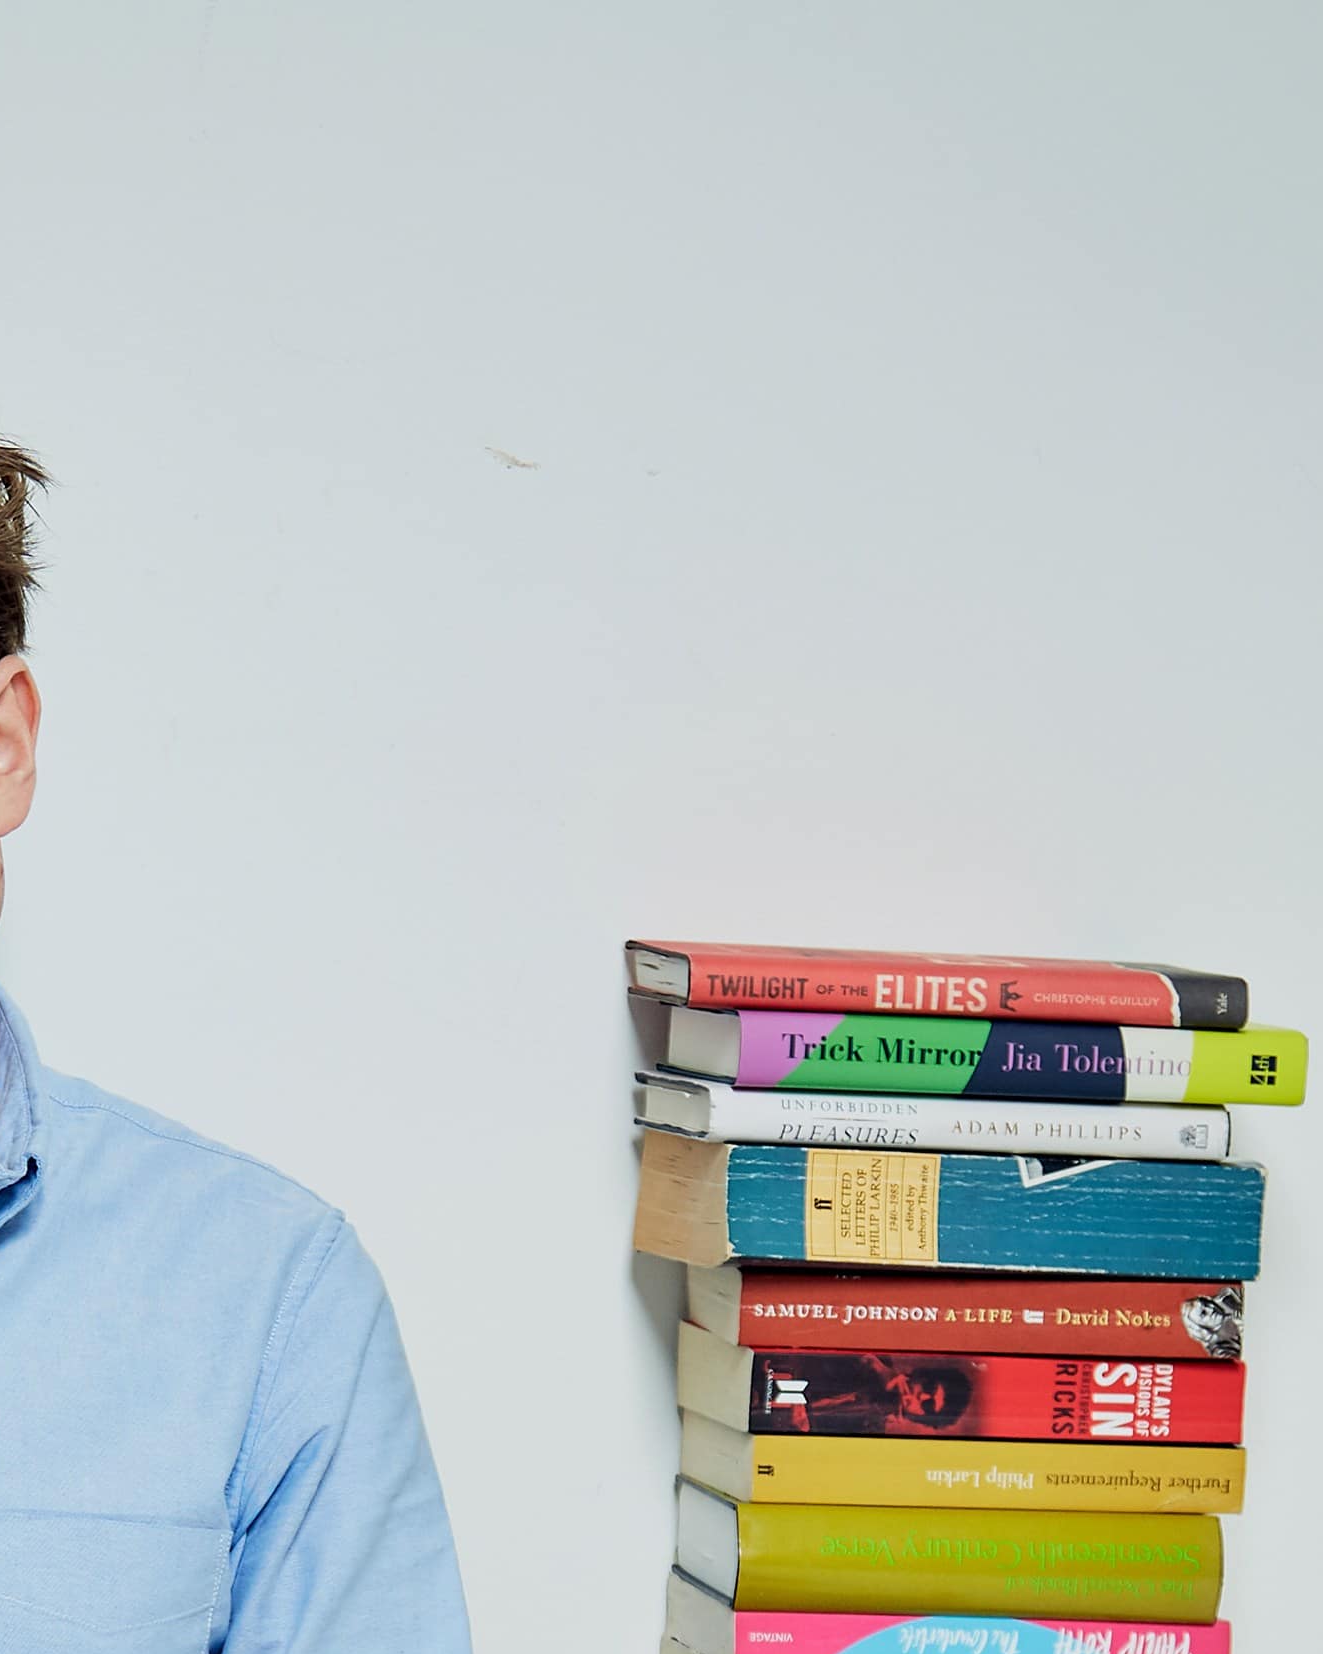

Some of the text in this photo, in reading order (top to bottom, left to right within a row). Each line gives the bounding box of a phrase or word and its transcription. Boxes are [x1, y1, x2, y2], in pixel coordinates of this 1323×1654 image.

[707, 974, 988, 1013] TWILIGHT OF THE ELITES
[782, 1033, 983, 1067] Trick Mirror
[1002, 1042, 1192, 1077] Jia Tolentino
[780, 1099, 919, 1115] UNFORBIDDEN
[779, 1124, 920, 1145] PLEASURES
[951, 1120, 1143, 1140] ADAM PHILLIPS
[840, 1171, 852, 1239] SELECTED
[753, 1303, 1013, 1324] SAMUEL JOHNSON A LIFE
[1056, 1308, 1171, 1328] David Nokes
[1052, 1363, 1078, 1436] RICKS
[1090, 1362, 1138, 1438] SIN
[1150, 1363, 1174, 1438] DYLAN'S
[926, 1465, 1231, 1494] Further Requirements Philip Larkin
[820, 1531, 1202, 1574] Seventeenth Century Verse
[749, 1631, 794, 1644] VINTAGE
